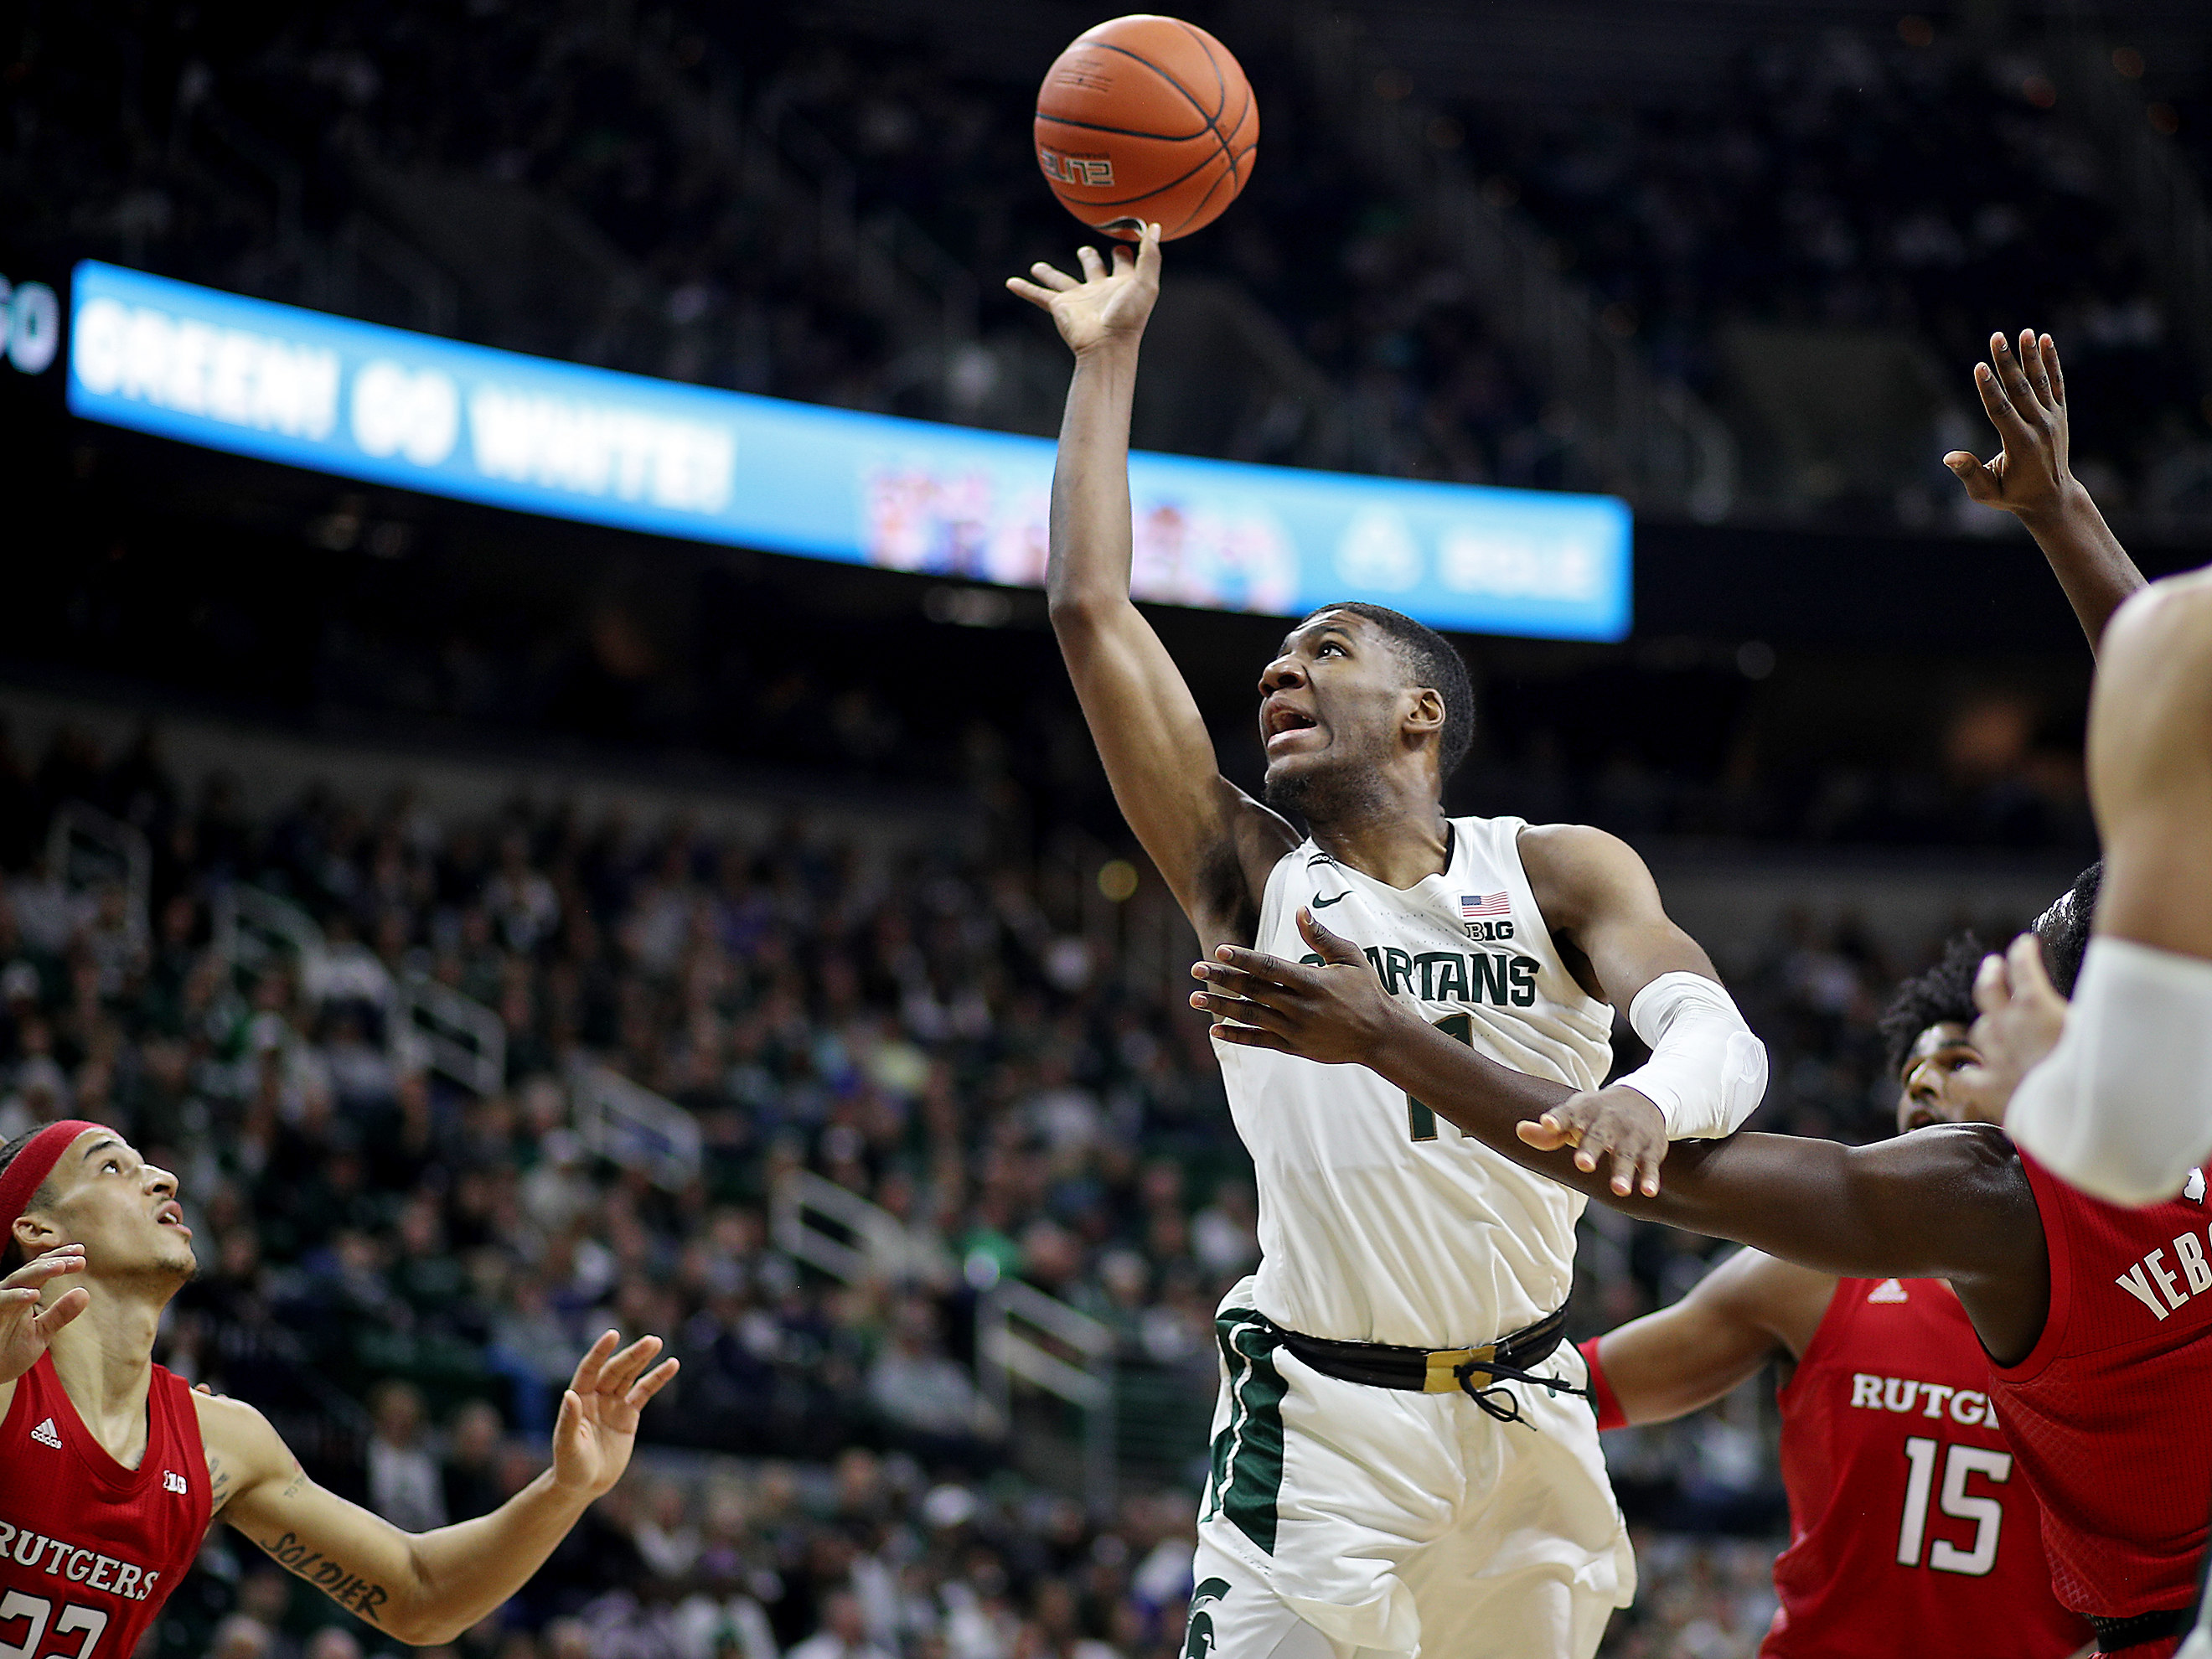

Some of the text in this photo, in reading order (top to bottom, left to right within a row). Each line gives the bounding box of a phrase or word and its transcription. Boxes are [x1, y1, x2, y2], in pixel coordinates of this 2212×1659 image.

[351, 358, 459, 467] GO
[2115, 1222, 2212, 1321] YEB
[1896, 1435, 2013, 1577] 15
[0, 1520, 160, 1601] RUTGERS
[261, 1532, 388, 1622] SOLDIER
